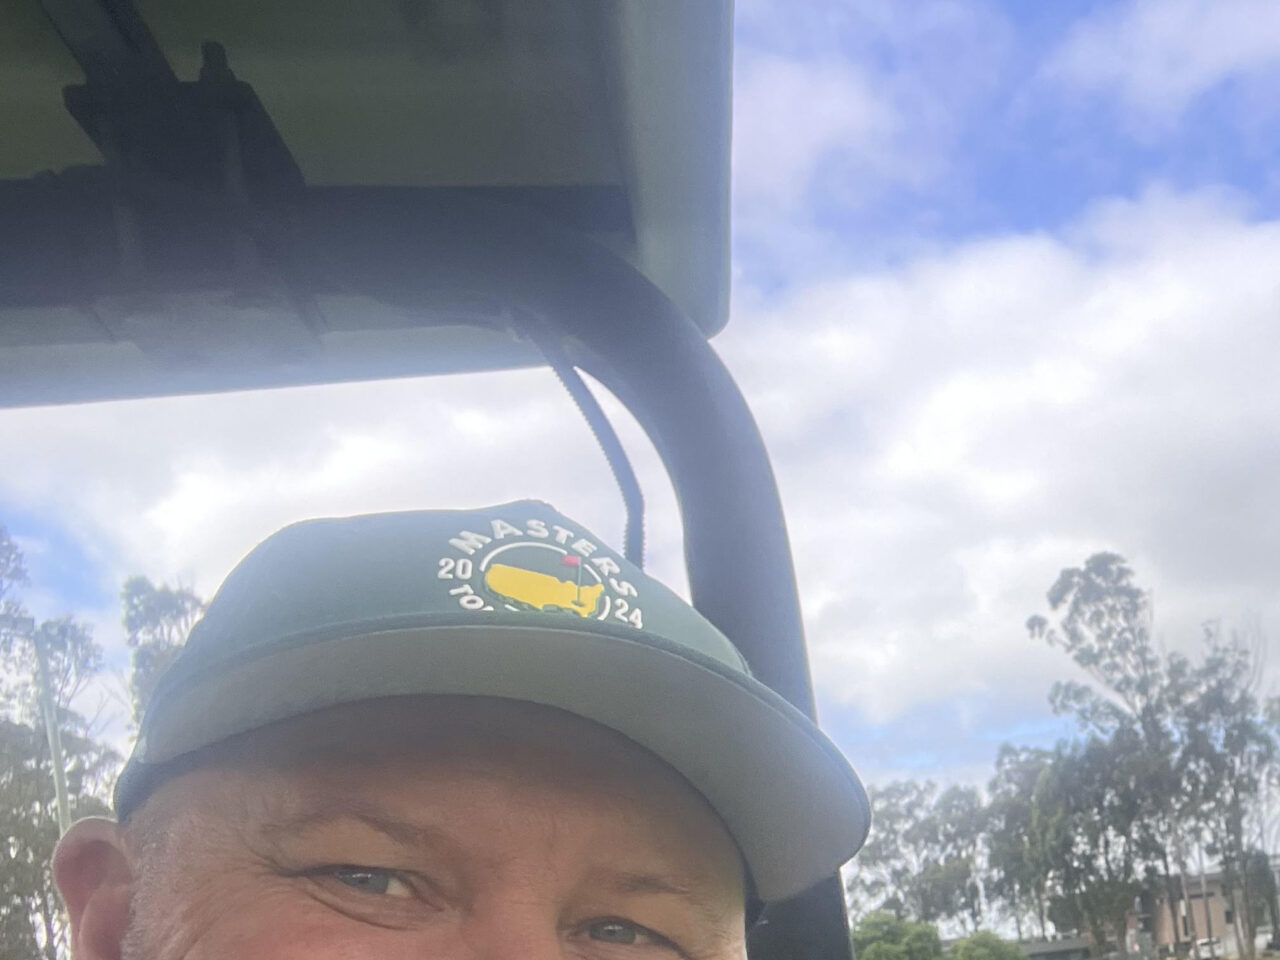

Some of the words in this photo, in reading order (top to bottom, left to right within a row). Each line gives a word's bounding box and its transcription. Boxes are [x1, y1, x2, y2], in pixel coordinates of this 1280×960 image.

[438, 557, 473, 580] 20
[448, 519, 638, 599] MASTERS
[615, 598, 643, 629] 24
